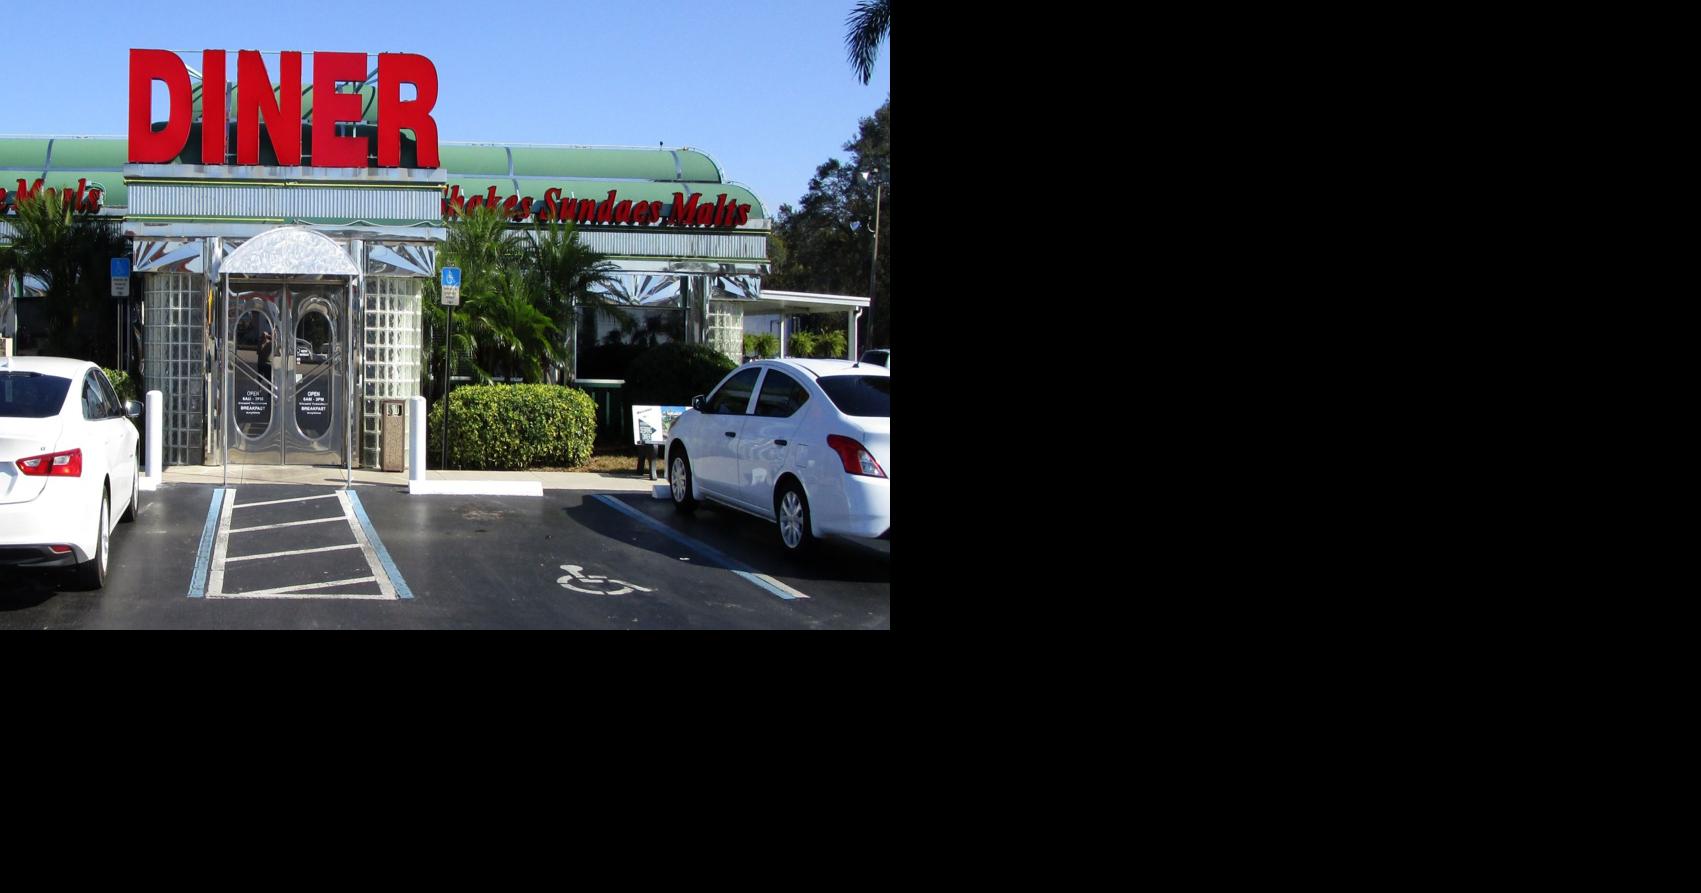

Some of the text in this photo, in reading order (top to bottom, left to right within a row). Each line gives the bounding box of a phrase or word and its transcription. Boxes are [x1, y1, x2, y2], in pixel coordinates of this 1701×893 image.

[128, 48, 440, 168] DINER
[10, 178, 102, 214] Mals
[538, 187, 663, 226] Sundaes
[666, 191, 752, 228] Malts
